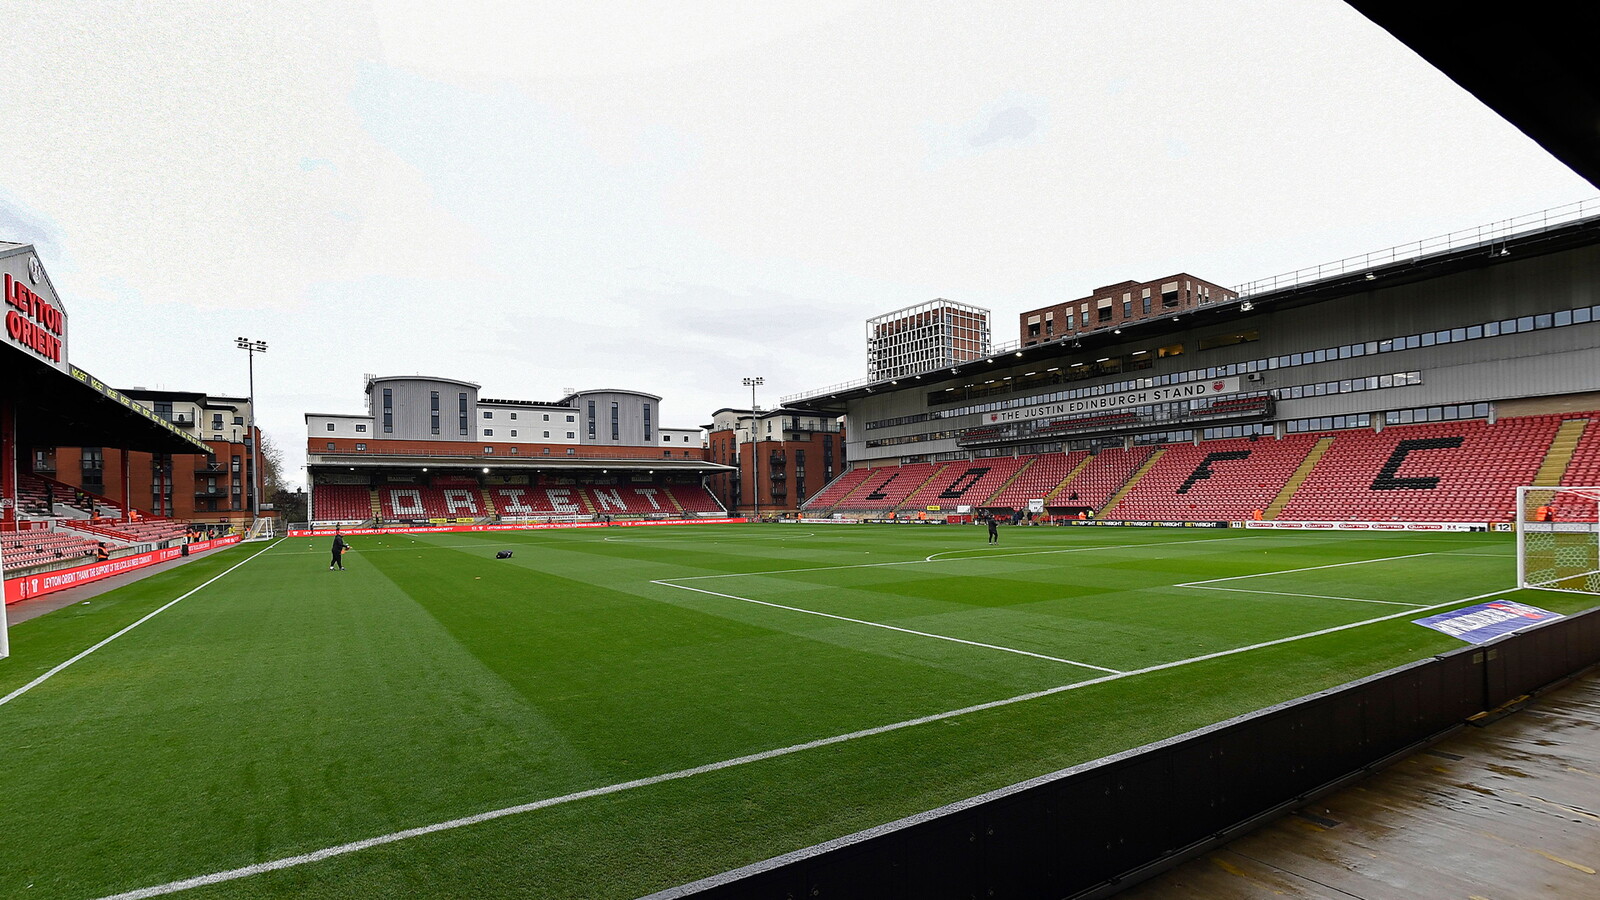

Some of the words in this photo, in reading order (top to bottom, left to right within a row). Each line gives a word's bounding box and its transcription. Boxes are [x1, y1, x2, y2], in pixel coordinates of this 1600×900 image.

[5, 272, 62, 335] LEYTON
[6, 310, 61, 362] ORIENT
[1002, 411, 1020, 420] THE
[1025, 405, 1064, 417] JUSTIN
[1070, 393, 1146, 412] EDINBURGH
[1154, 384, 1206, 400] STAND
[390, 489, 661, 514] ORIENT
[43, 573, 61, 588] LEYTON
[61, 571, 75, 584] ORIENT
[76, 568, 89, 580] THANK
[95, 564, 109, 576] SUPPORT
